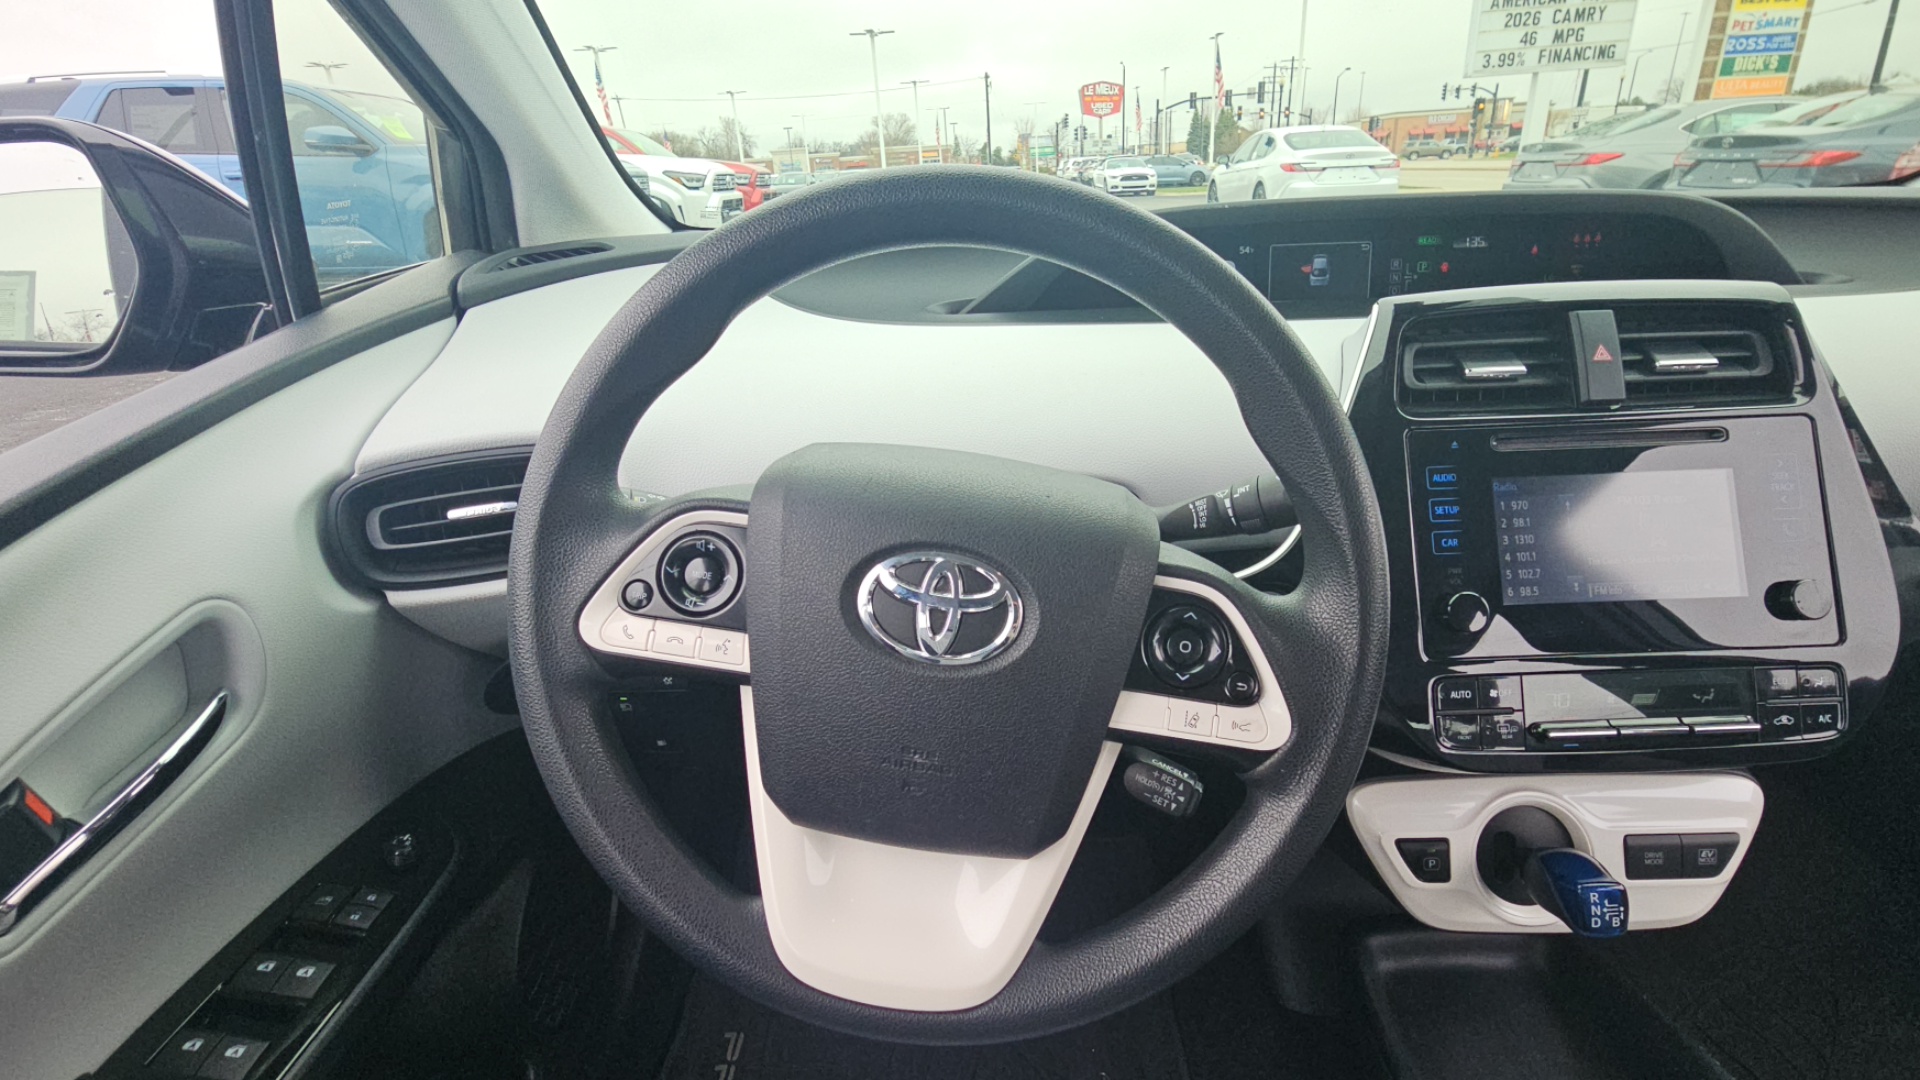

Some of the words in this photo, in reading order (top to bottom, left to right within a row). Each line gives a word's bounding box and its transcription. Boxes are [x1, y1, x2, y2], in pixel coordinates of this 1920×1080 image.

[1504, 11, 1542, 28] 2026
[1552, 5, 1608, 24] CAMRY
[1519, 31, 1538, 46] 46
[1552, 27, 1586, 44] MPG
[1725, 37, 1767, 52] ROSS
[1482, 51, 1526, 69] 3.99%
[1537, 44, 1617, 64] FINANCING
[1734, 55, 1780, 71] DICK'S
[1084, 85, 1094, 96] LE
[1433, 474, 1456, 482] AUDIO
[1434, 506, 1460, 514] SETUP
[1500, 502, 1504, 510] 1
[1511, 501, 1528, 510] 970
[1501, 519, 1507, 528] 2
[1512, 518, 1530, 528] 98.1
[1441, 538, 1458, 547] CAR
[1502, 536, 1508, 545] 3
[1514, 535, 1534, 544] 1310
[1504, 553, 1511, 562] 4
[1516, 552, 1536, 562] 101.1
[1506, 570, 1512, 580] 5
[1518, 569, 1540, 579] 102.7
[1508, 588, 1514, 597] 6
[1520, 587, 1540, 596] 98.5
[1450, 690, 1472, 699] AUTO
[1818, 714, 1832, 723] A/C
[1152, 758, 1182, 776] CANCEL
[1160, 773, 1178, 787] RES
[1152, 794, 1170, 808] SET
[1428, 859, 1436, 868] P
[1590, 892, 1600, 904] R
[1591, 905, 1601, 916] N
[1592, 917, 1602, 928] D
[1612, 916, 1620, 927] B
